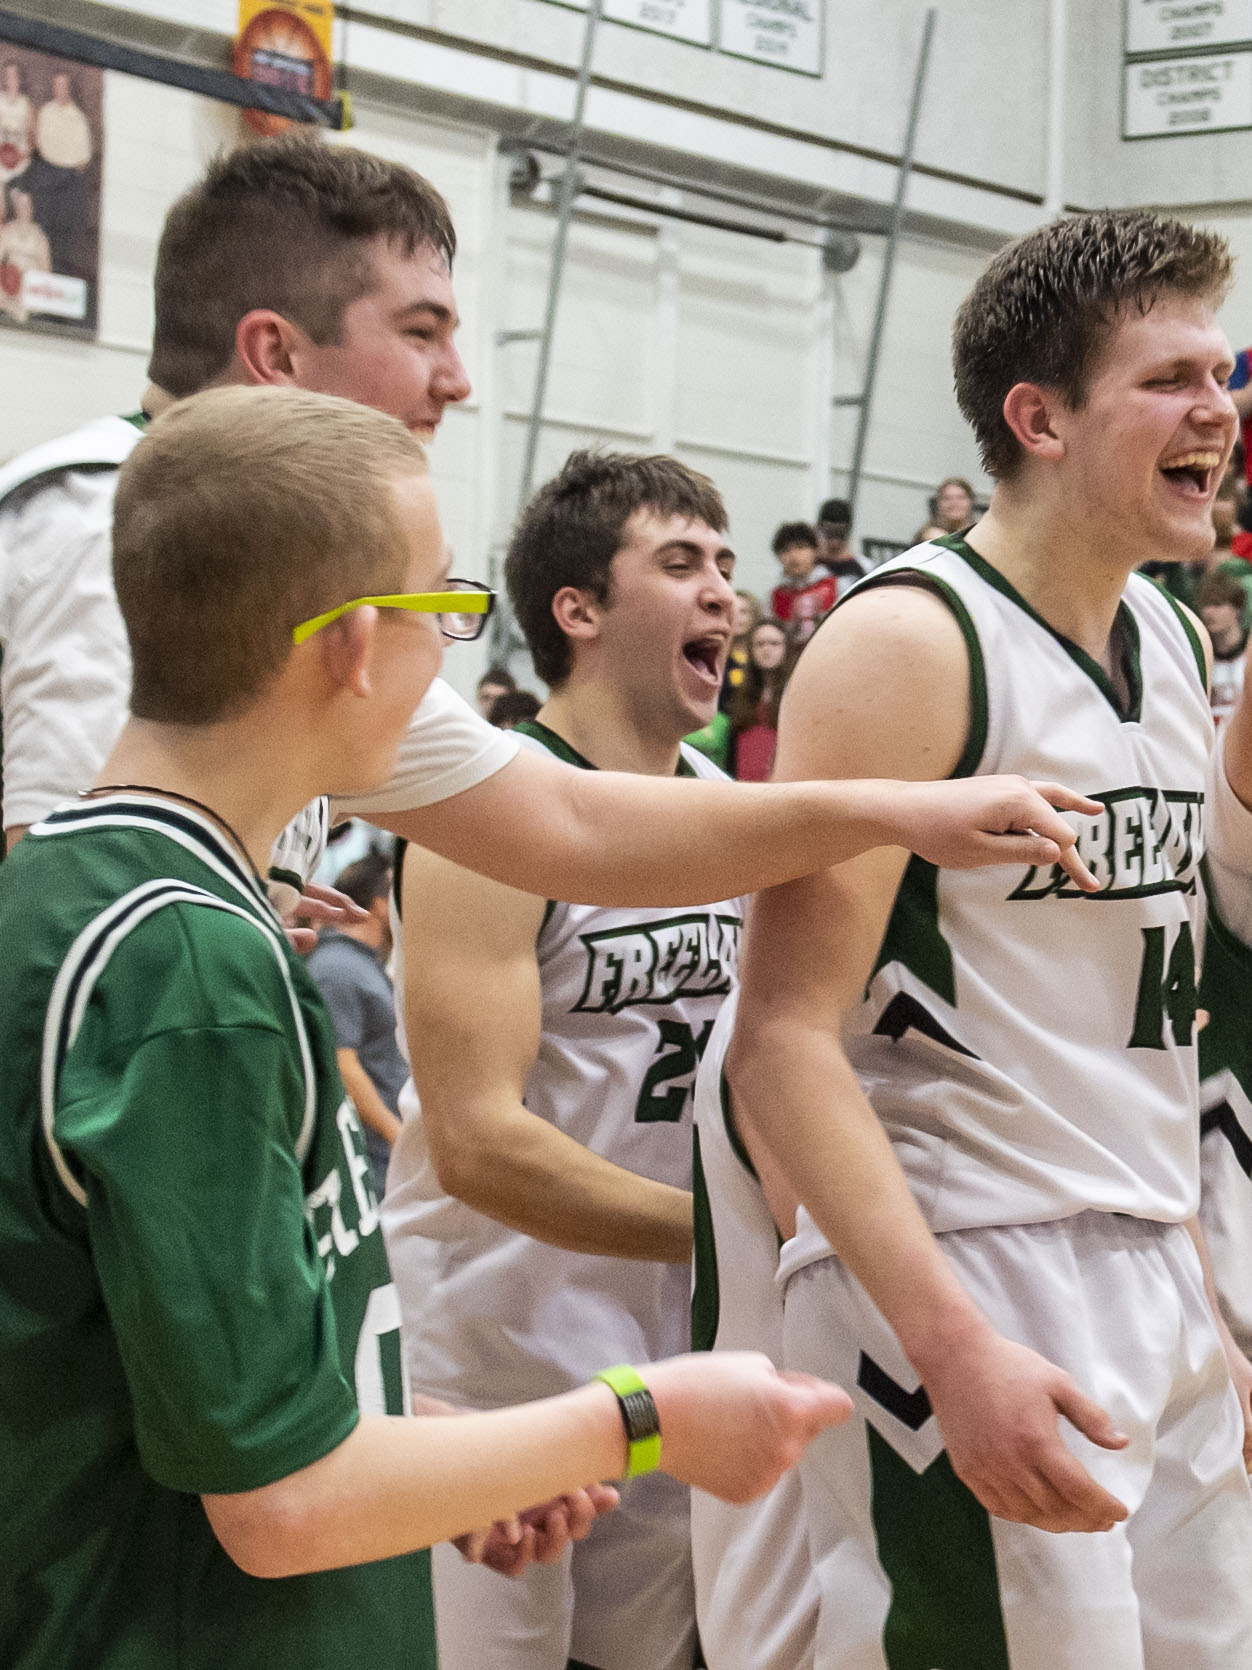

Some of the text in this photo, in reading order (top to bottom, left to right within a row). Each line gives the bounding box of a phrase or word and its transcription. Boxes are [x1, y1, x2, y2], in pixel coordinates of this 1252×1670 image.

[1140, 60, 1233, 88] DISTRICT
[1157, 86, 1221, 106] CHAMPS
[1126, 920, 1197, 1051] 14
[634, 1018, 716, 1123] 2
